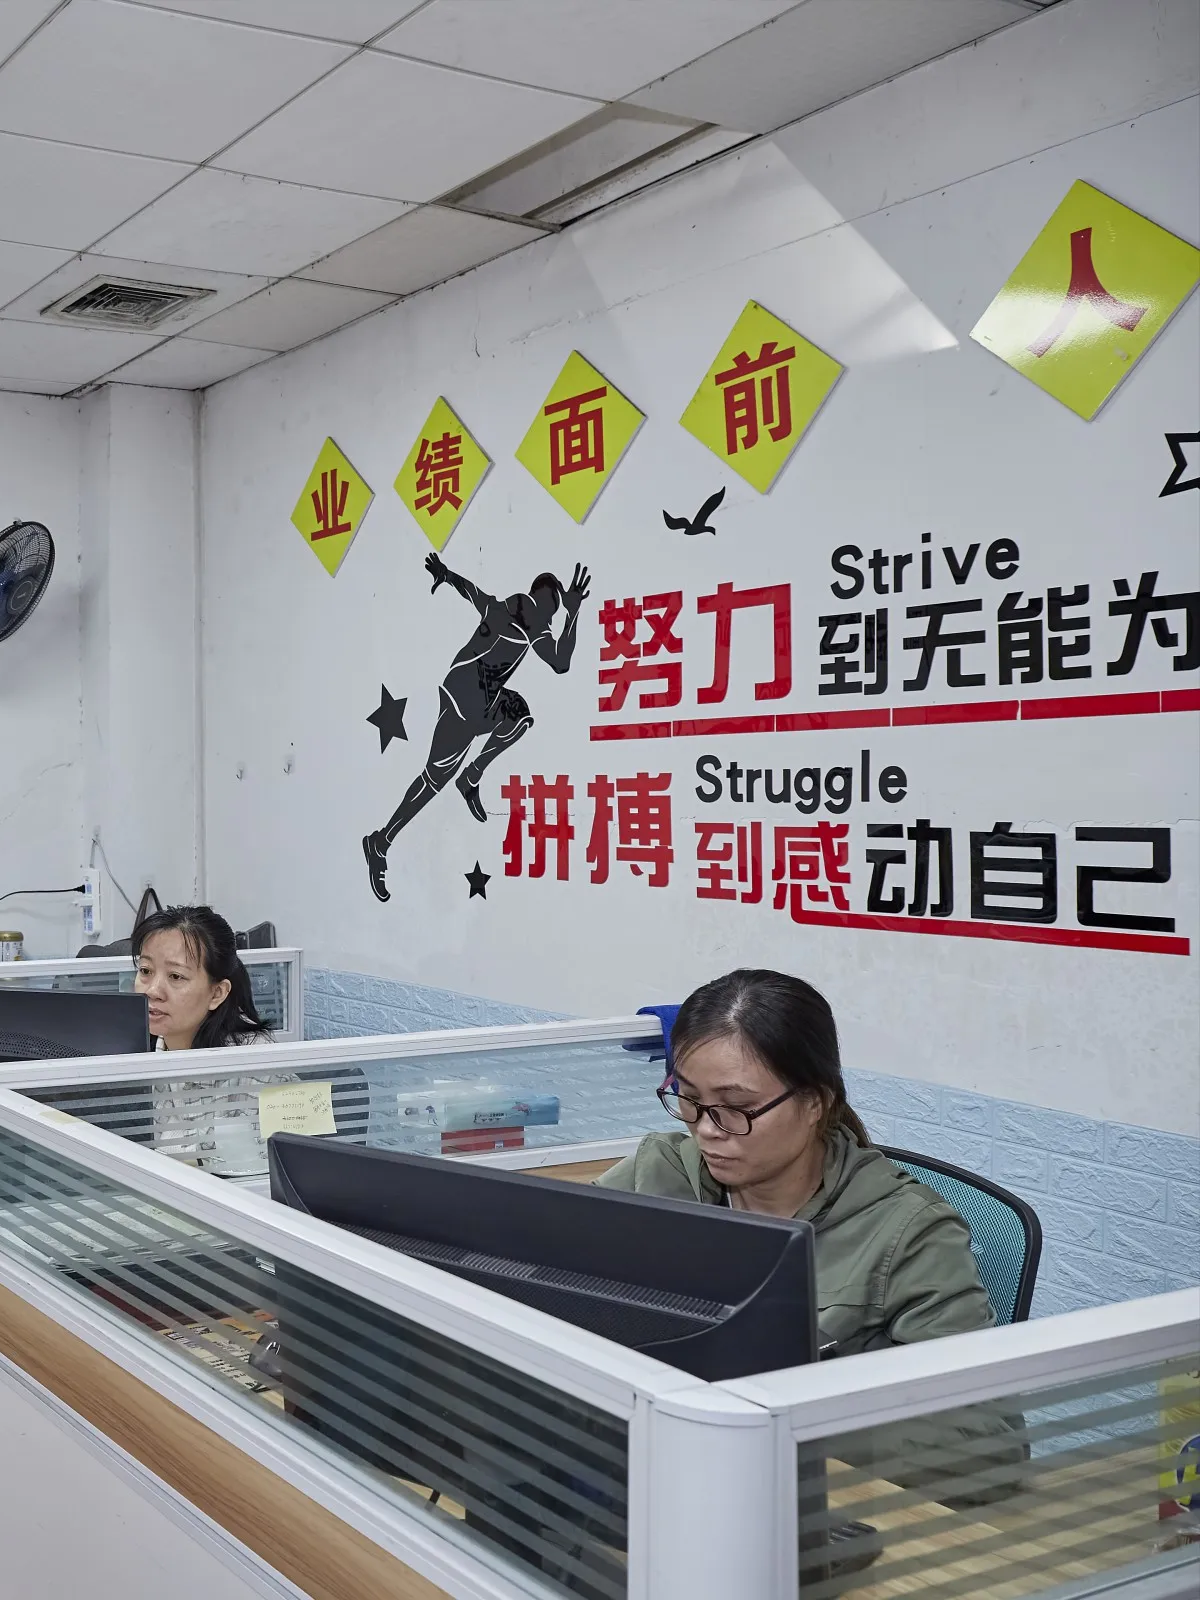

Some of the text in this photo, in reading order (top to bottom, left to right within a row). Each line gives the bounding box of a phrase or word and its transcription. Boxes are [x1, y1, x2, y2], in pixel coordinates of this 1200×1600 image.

[310, 227, 1149, 541] 业 绩 面 前 人
[830, 532, 1021, 600] Strive
[695, 749, 908, 815] Struggle
[501, 772, 1176, 933] 拼搏到感动自己
